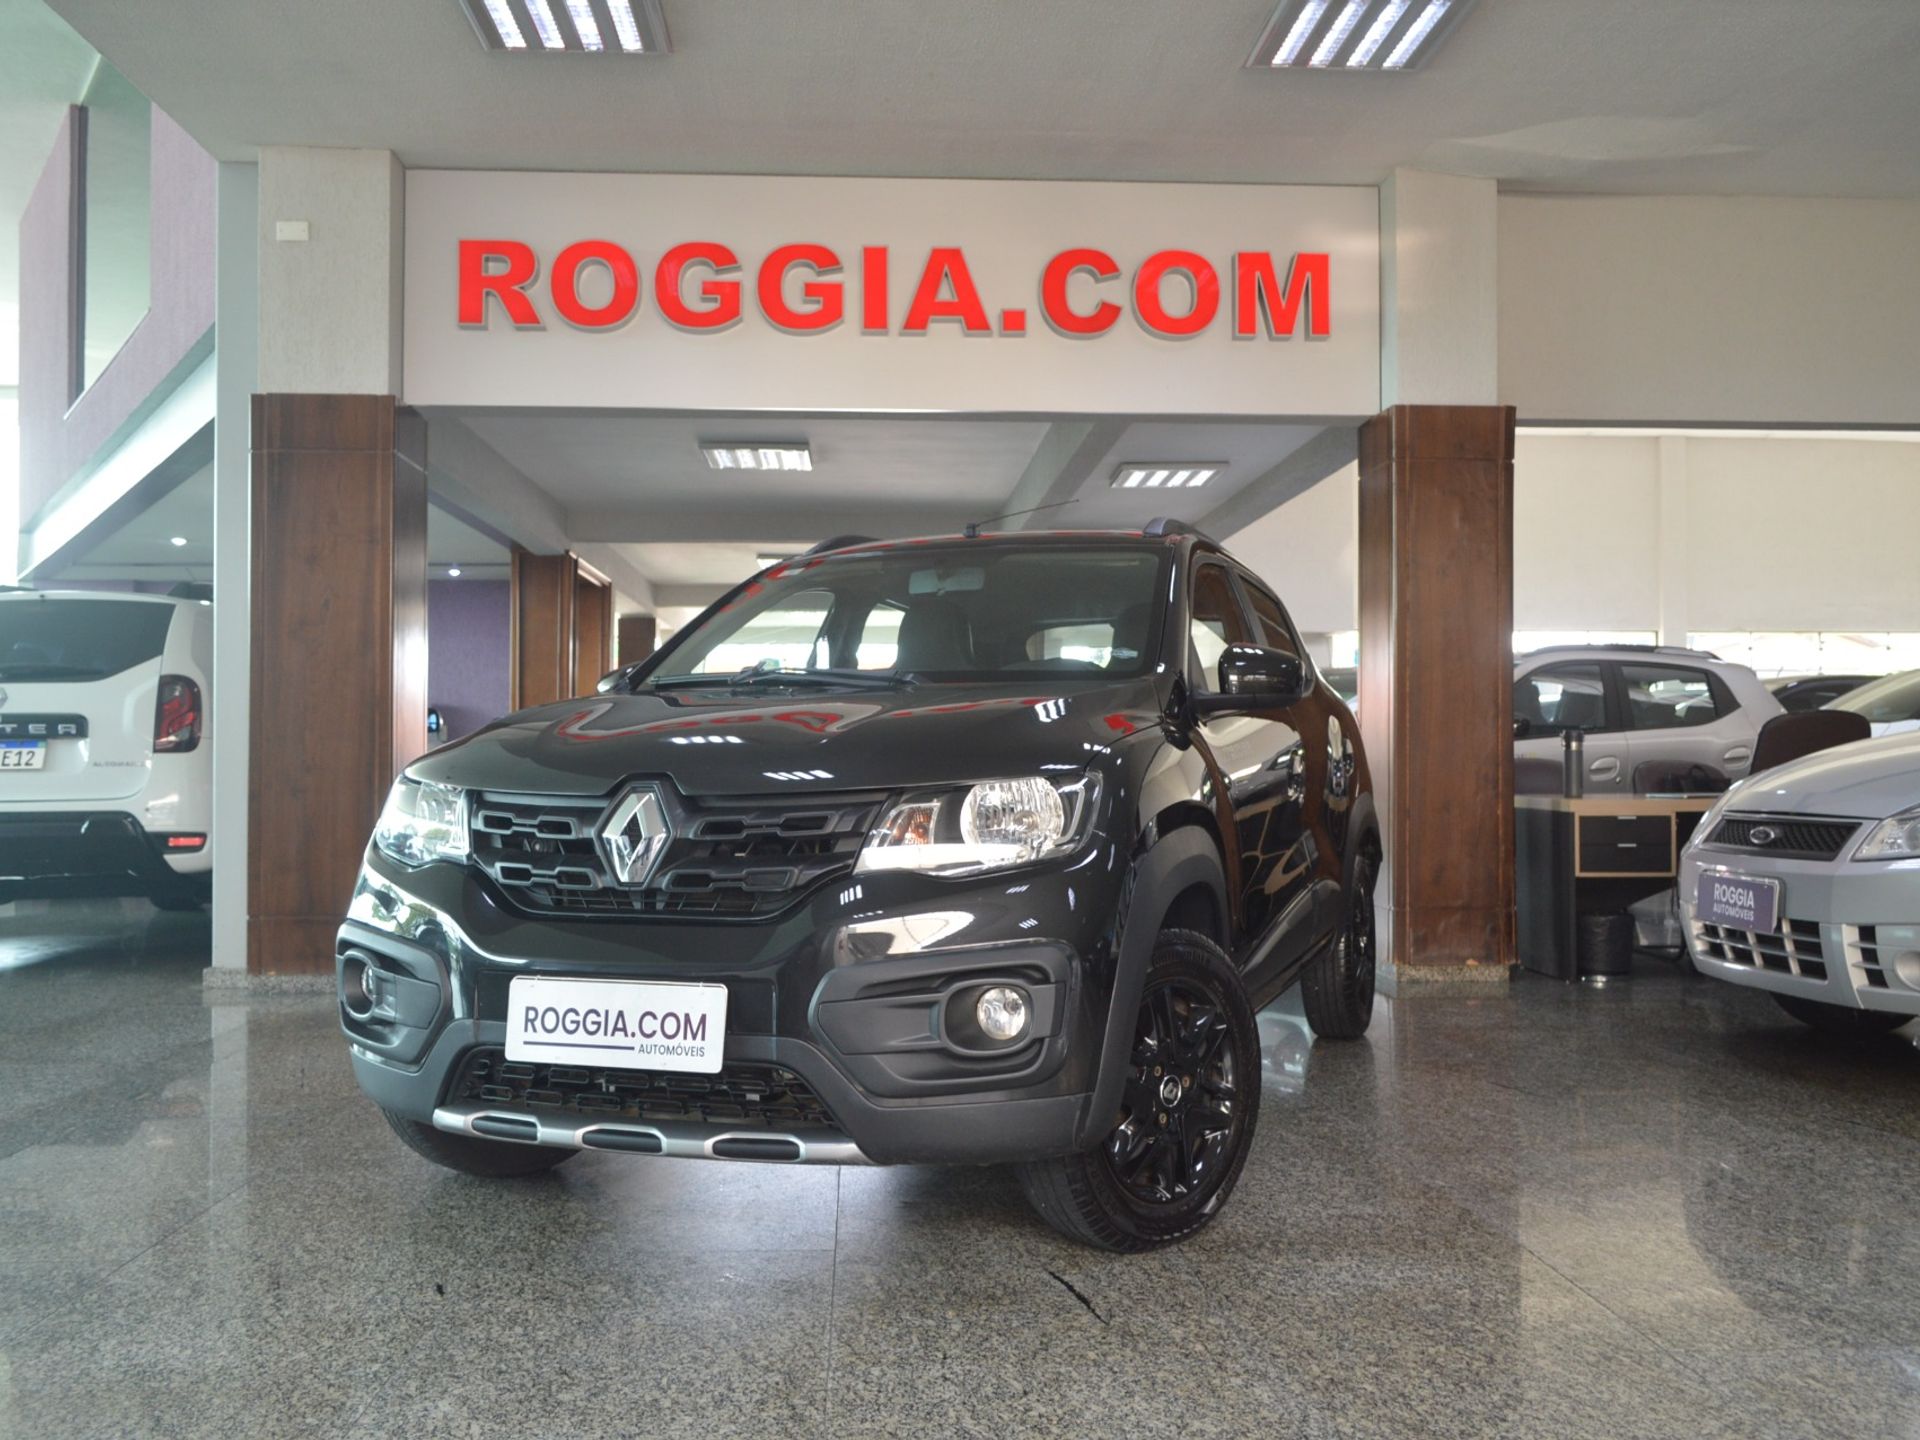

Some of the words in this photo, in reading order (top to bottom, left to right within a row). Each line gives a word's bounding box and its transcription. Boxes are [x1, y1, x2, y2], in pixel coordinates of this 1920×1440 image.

[459, 239, 1330, 339] ROGGIA.COM
[1, 750, 35, 767] E12
[1714, 883, 1754, 908] ROGGIA
[1713, 903, 1754, 920] AUTOMÓVEIS
[524, 1006, 707, 1041] ROGGIA.COM
[638, 1043, 705, 1057] AUTOMÓVEIS
